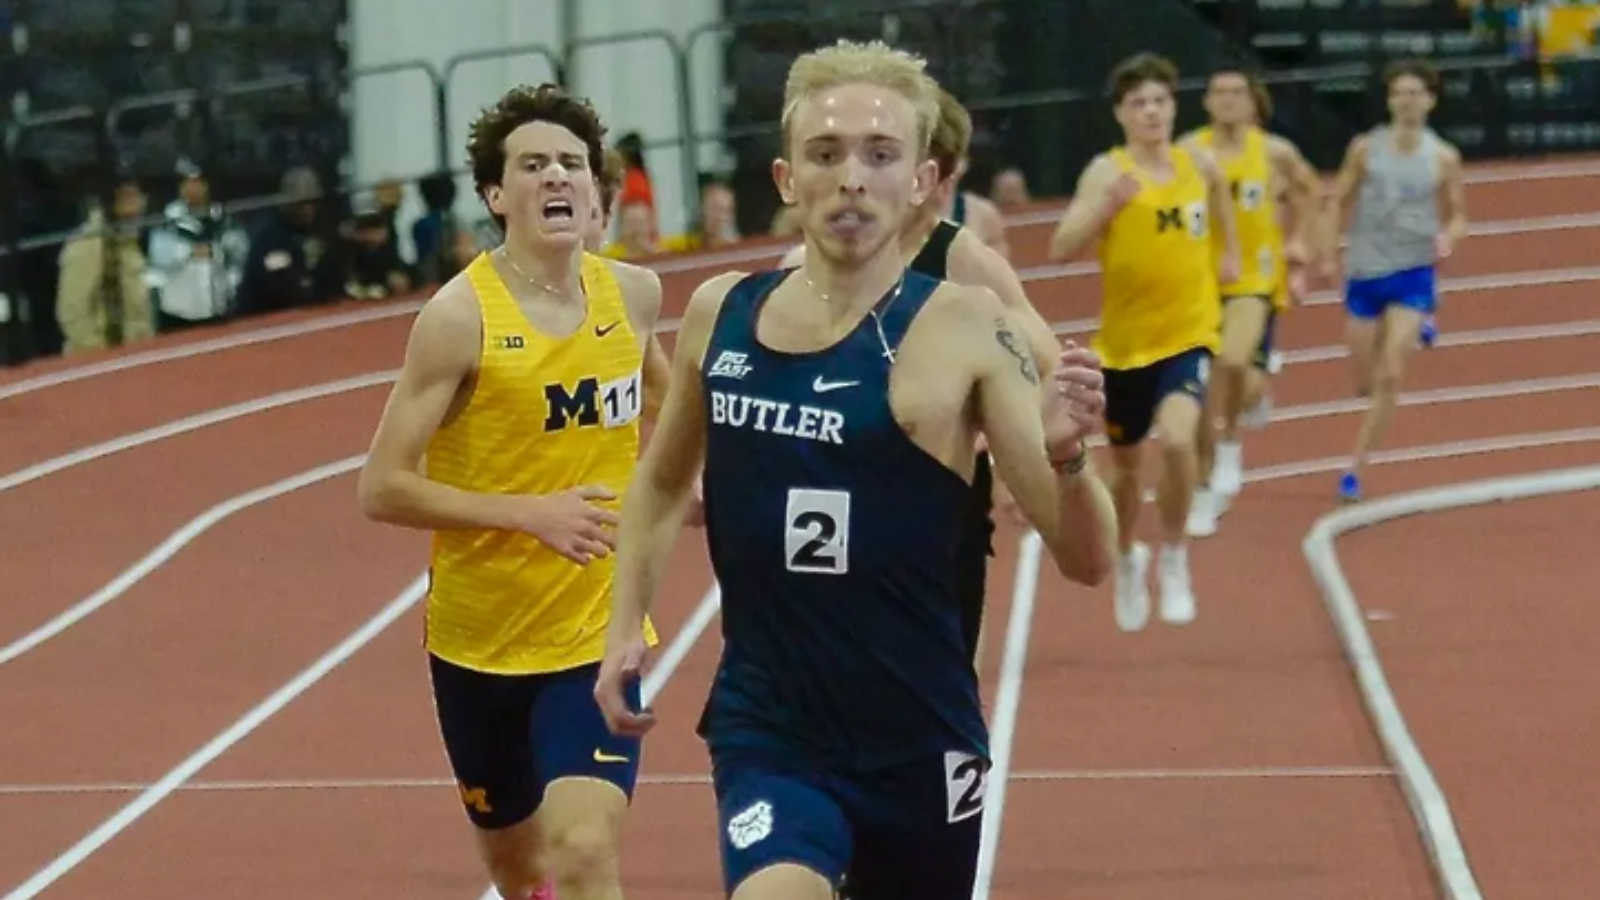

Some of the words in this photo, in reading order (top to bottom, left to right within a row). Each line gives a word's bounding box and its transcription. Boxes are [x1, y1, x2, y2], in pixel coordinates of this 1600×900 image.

[544, 378, 599, 432] M
[604, 378, 637, 418] 11
[711, 391, 845, 444] BUTLER
[791, 511, 837, 570] 2
[951, 757, 992, 818] 2
